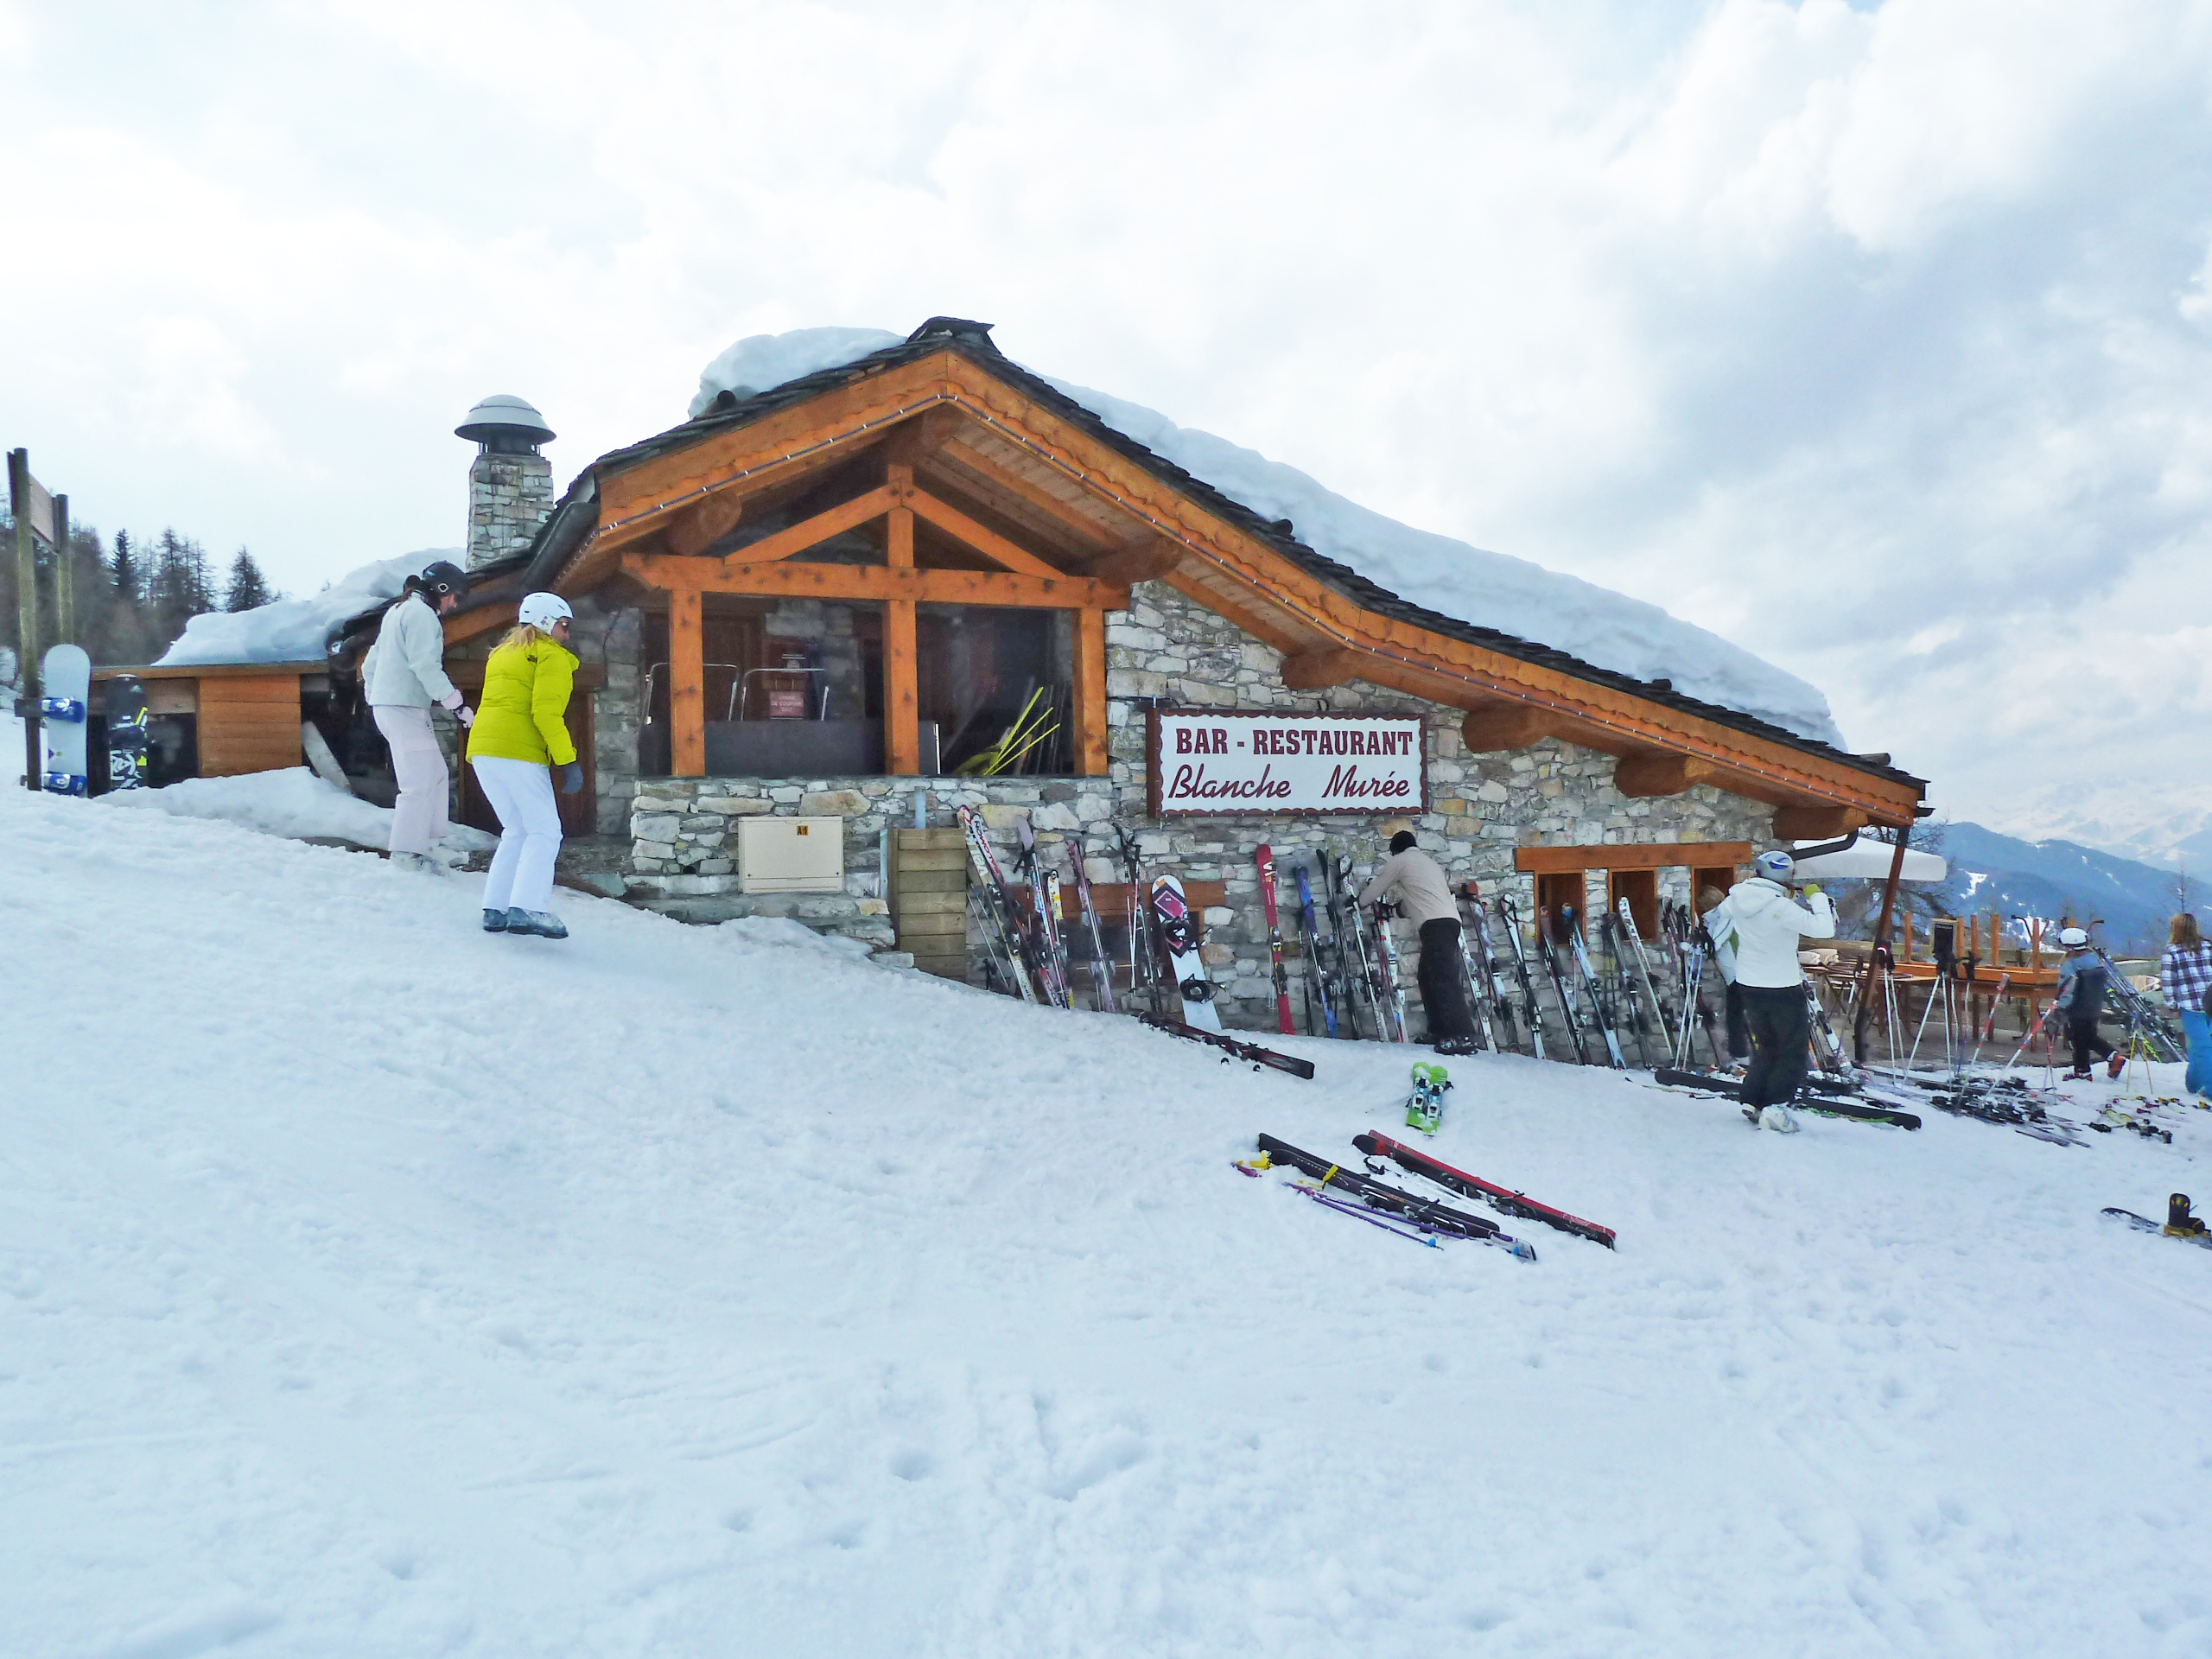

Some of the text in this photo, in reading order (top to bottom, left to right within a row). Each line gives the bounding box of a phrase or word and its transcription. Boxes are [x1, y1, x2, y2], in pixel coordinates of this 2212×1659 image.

[1175, 728, 1229, 754] BAR
[1253, 729, 1413, 755] RESTAURANT
[1168, 763, 1410, 798] Blanche Murée
